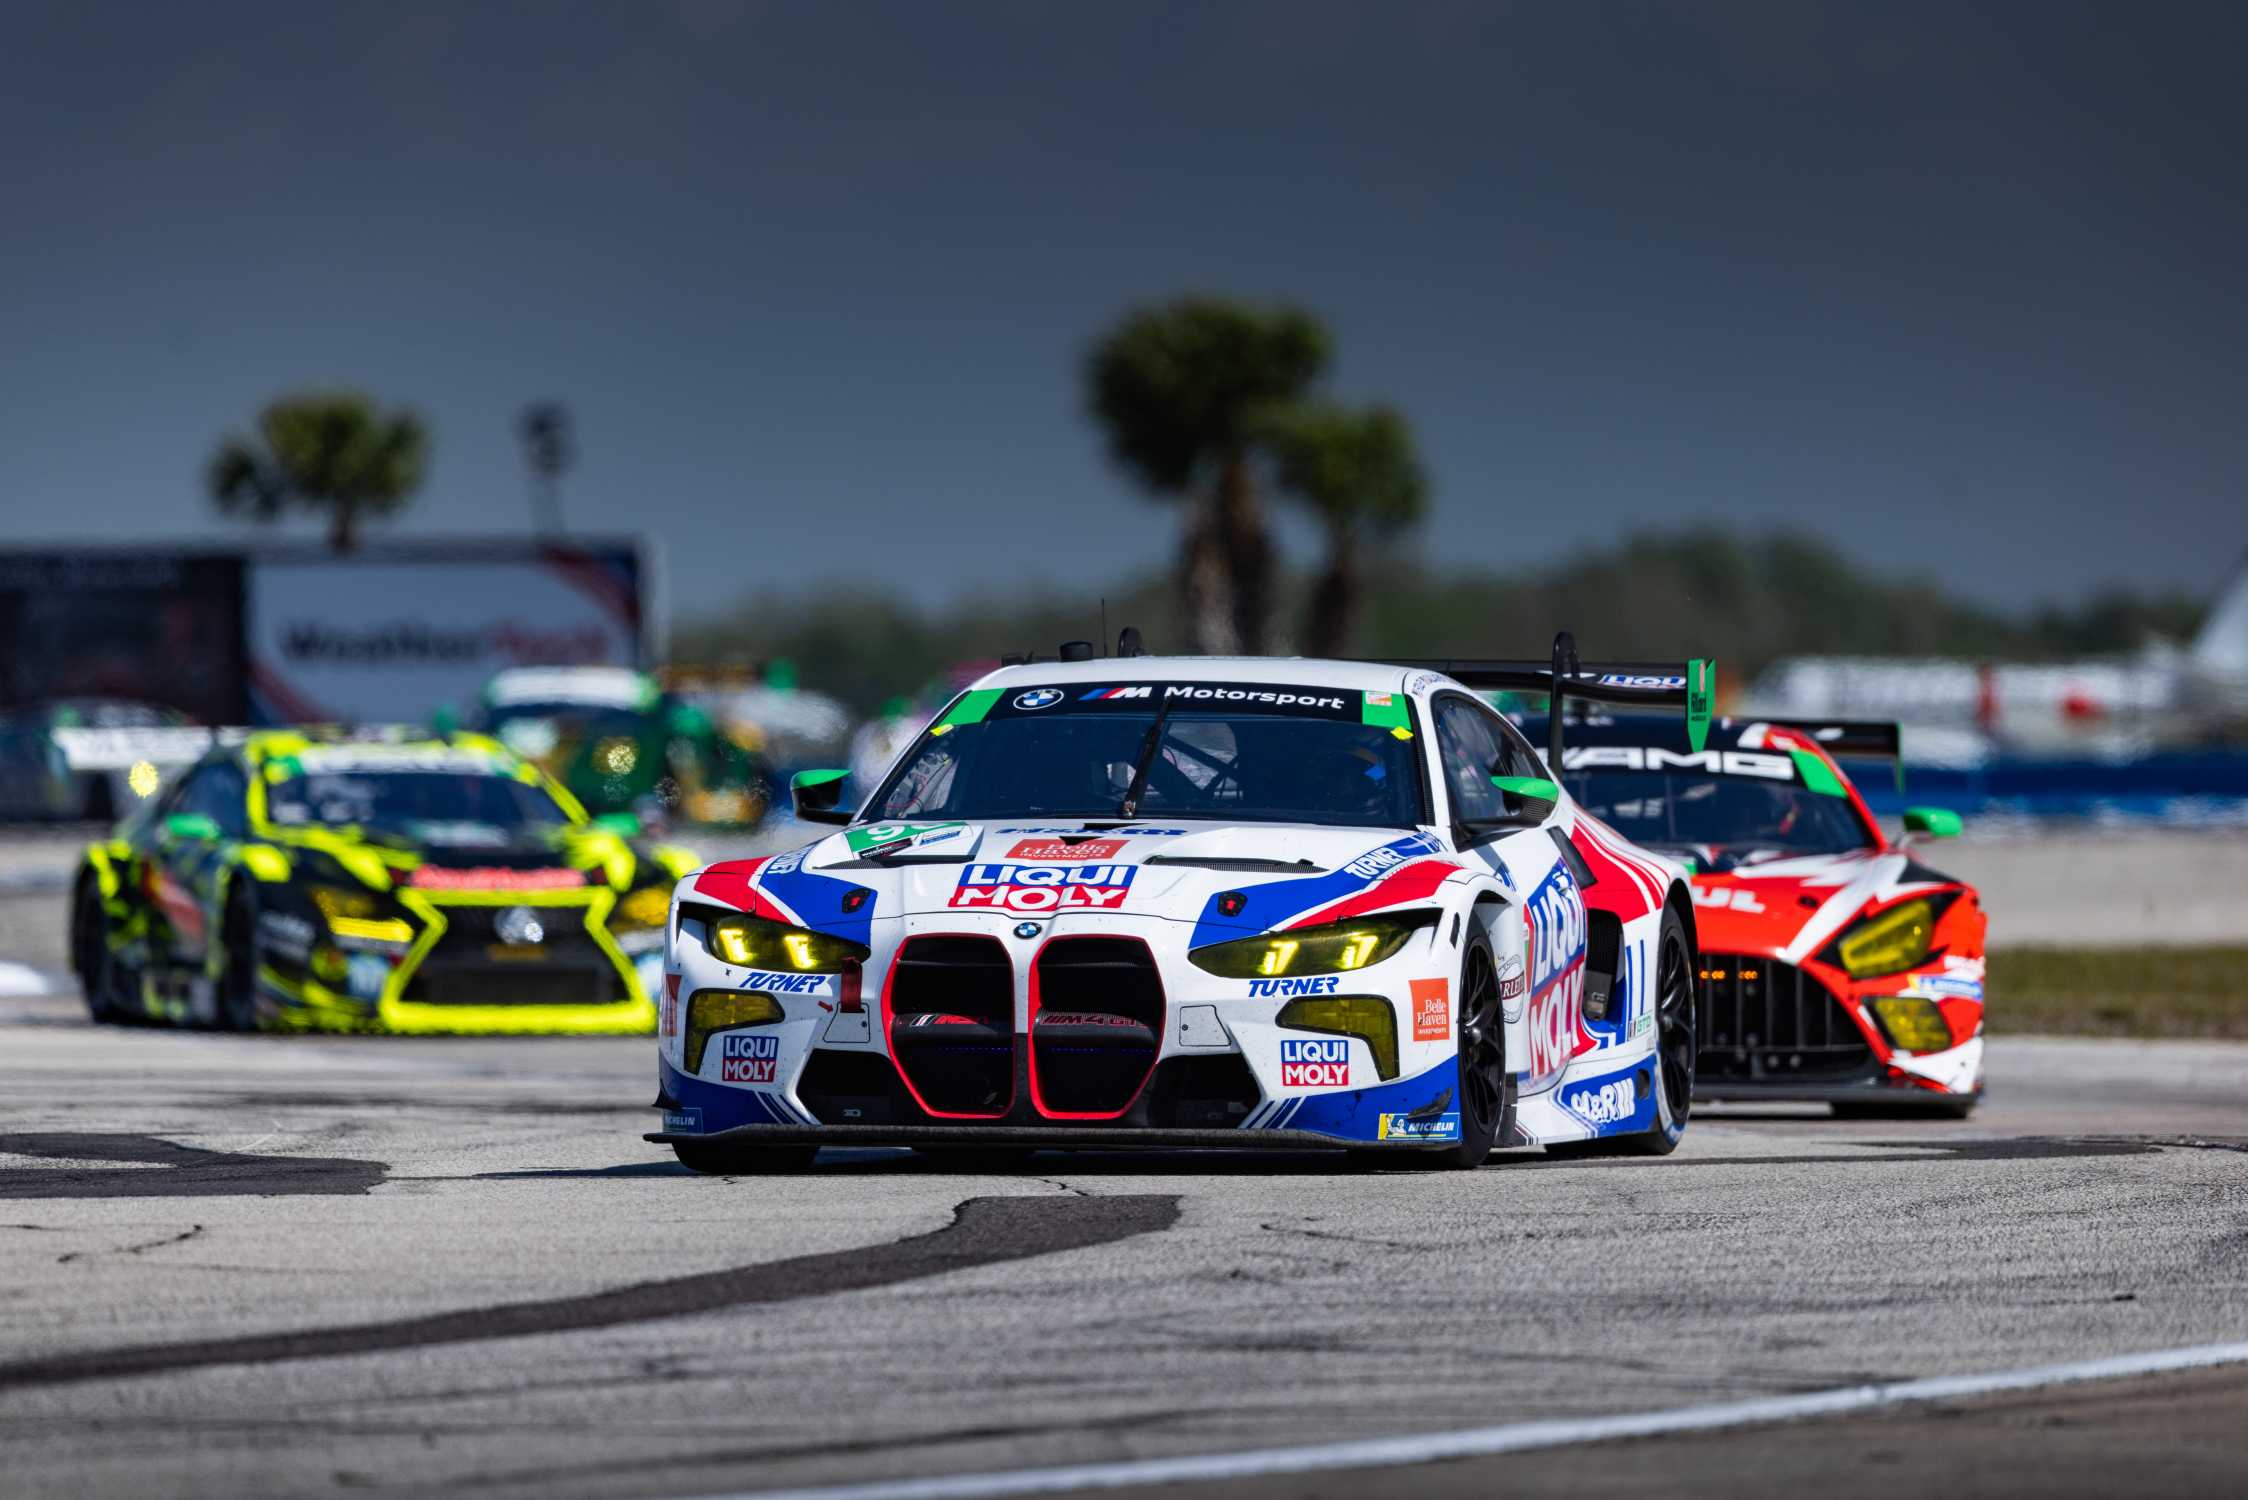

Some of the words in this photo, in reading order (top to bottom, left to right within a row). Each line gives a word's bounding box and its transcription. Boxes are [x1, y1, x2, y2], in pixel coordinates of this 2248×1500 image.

[1599, 674, 1686, 687] LIQU
[1164, 686, 1345, 710] Motorsport
[1344, 847, 1406, 880] TURNER
[967, 865, 1128, 887] LIQUI
[957, 886, 1126, 910] MOLY
[1532, 884, 1585, 988] LIQUI
[739, 971, 826, 993] TURNER
[1248, 976, 1339, 997] TURNER
[1425, 999, 1447, 1013] Belle
[1417, 1012, 1447, 1025] Haven
[1531, 963, 1585, 1080] MOLY
[726, 1037, 777, 1058] LIQUI
[1283, 1041, 1346, 1063] LIQUI
[724, 1060, 775, 1082] MOLY
[1286, 1064, 1348, 1085] MOLY
[1408, 1121, 1454, 1133] MICHELIN
